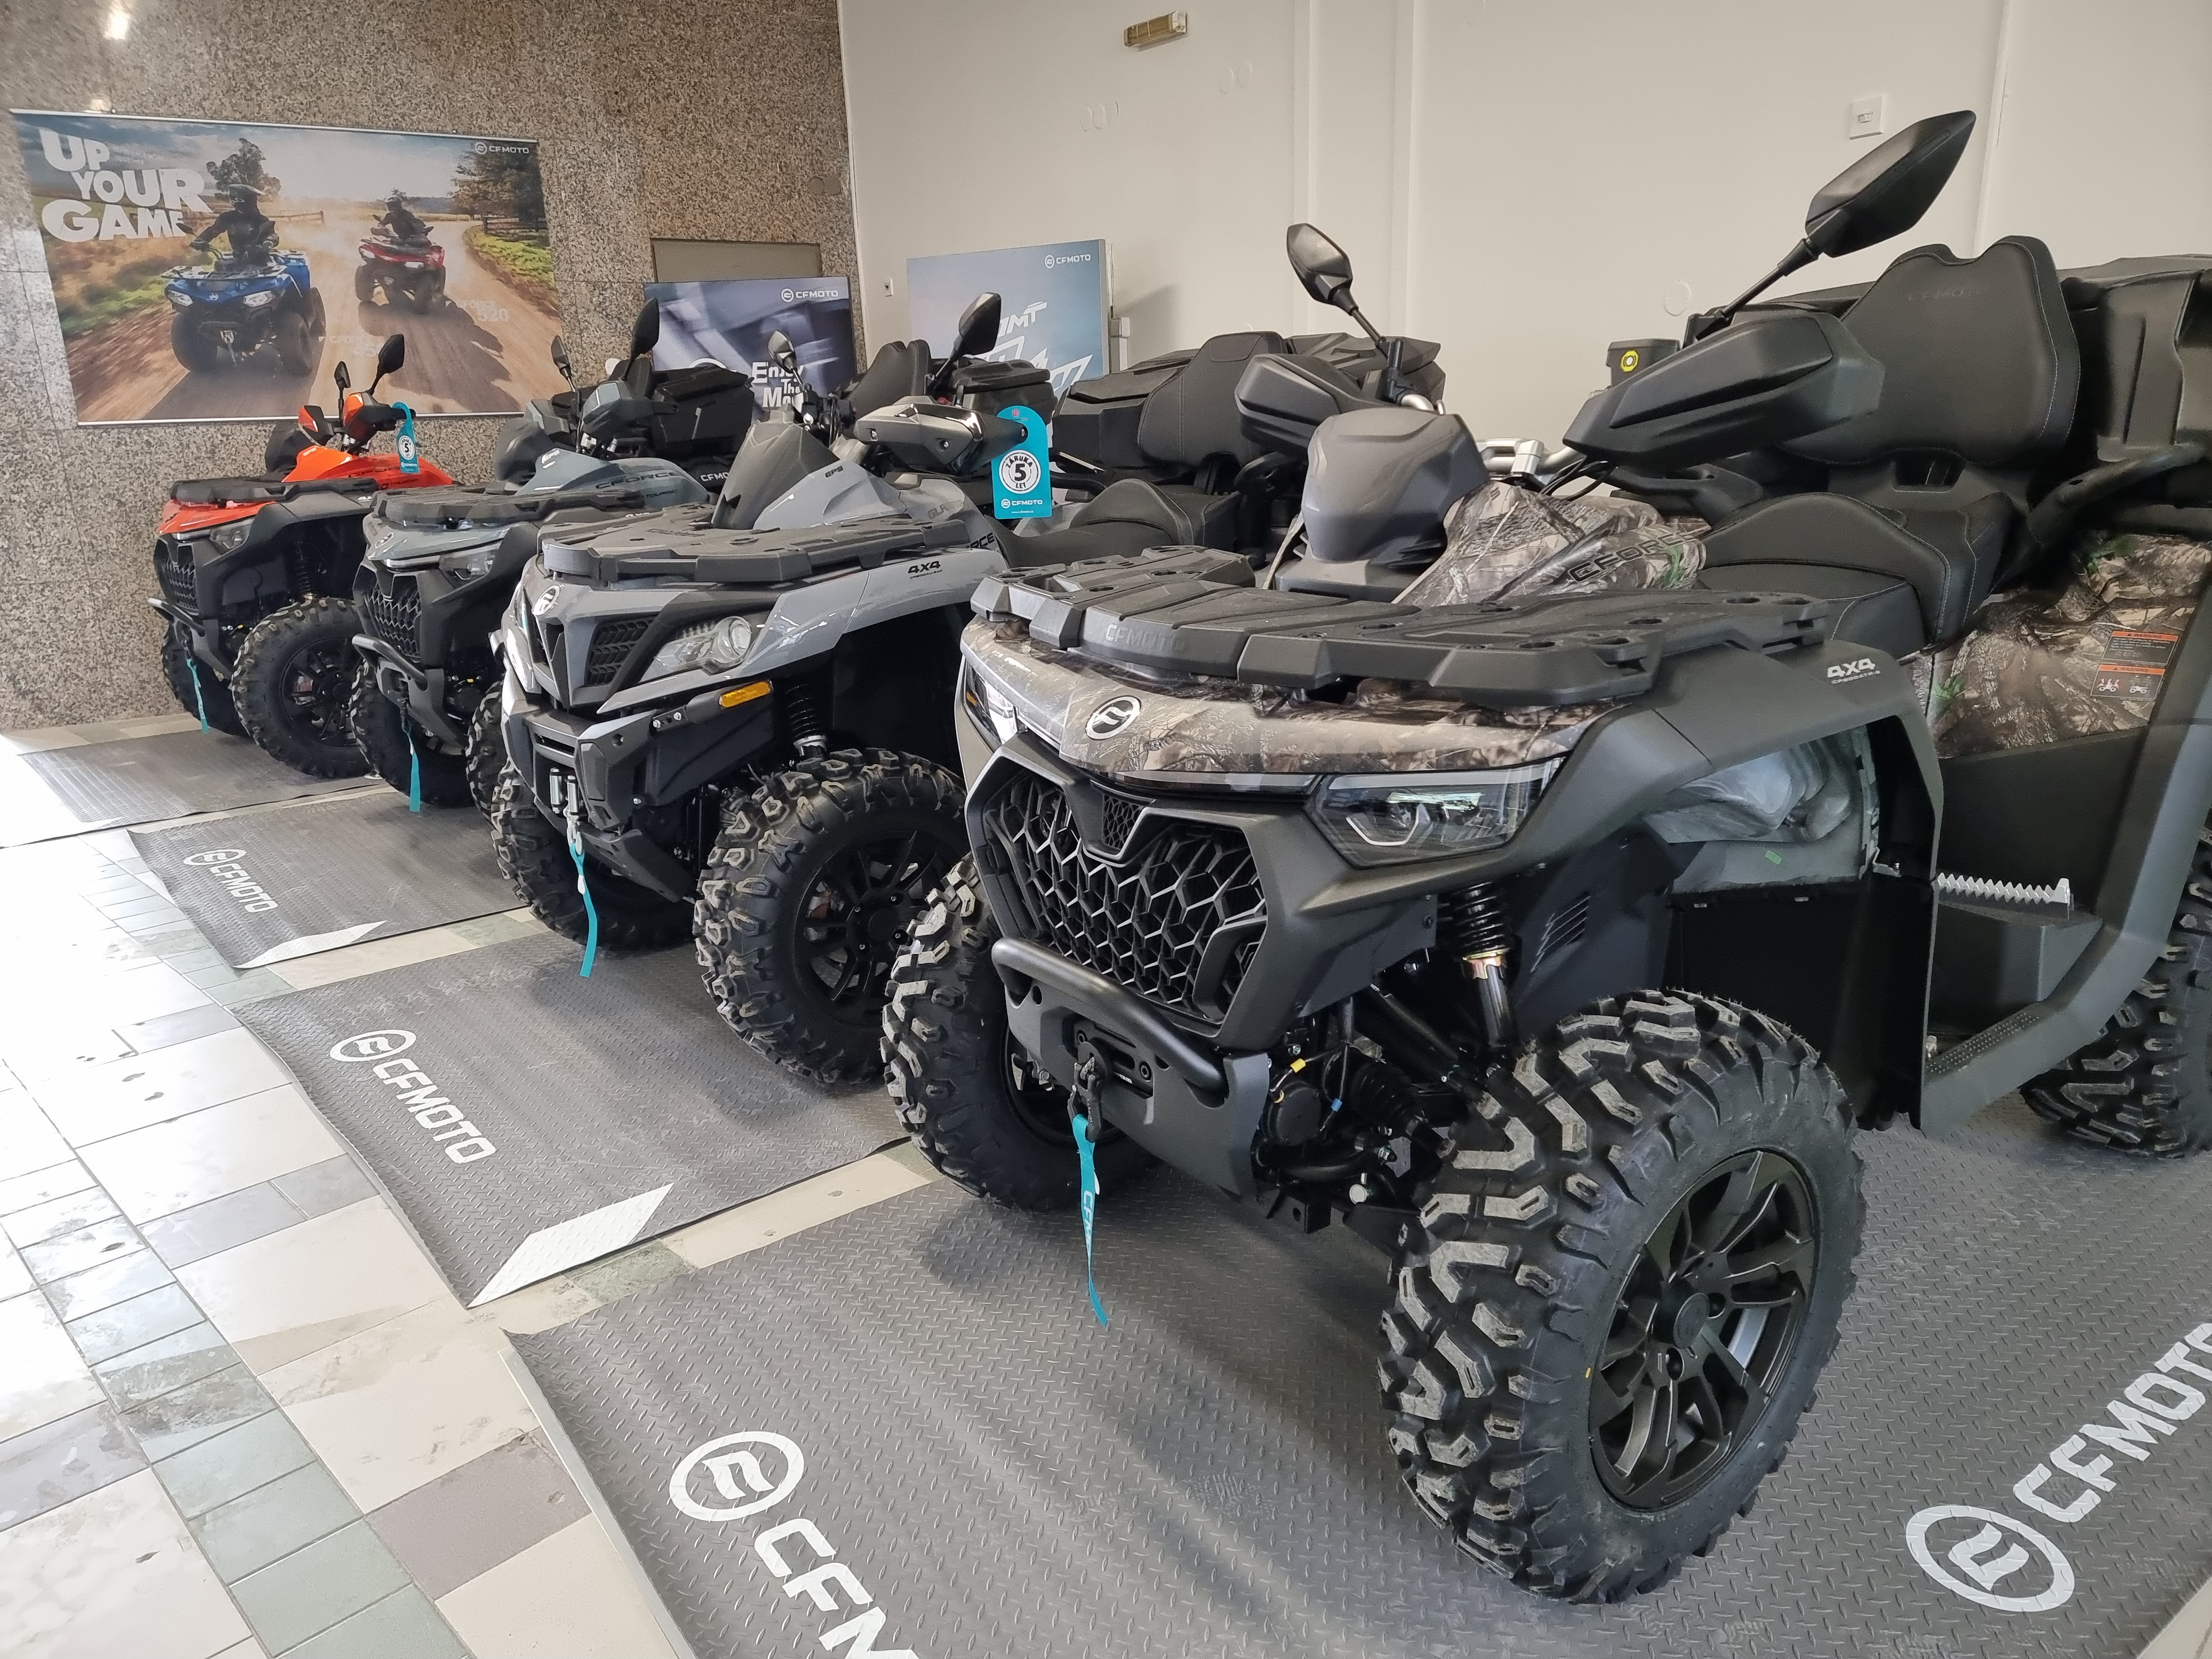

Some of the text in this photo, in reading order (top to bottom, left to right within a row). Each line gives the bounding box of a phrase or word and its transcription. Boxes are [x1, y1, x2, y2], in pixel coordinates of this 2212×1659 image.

[39, 127, 110, 171] UP
[489, 145, 529, 154] CFMOTO
[71, 168, 213, 213] YOUR
[41, 199, 186, 242] GAME
[1056, 254, 1091, 264] CFMOTO
[795, 290, 839, 299] CFMOTO
[780, 378, 801, 394] The
[404, 442, 409, 452] 5
[1005, 455, 1033, 469] ZÁRUKA
[595, 471, 681, 489] CFORCE
[825, 465, 844, 478] EPS
[1014, 463, 1027, 481] 5
[907, 560, 941, 574] 4X4
[1105, 623, 1188, 651] CFMOTO
[1827, 658, 1876, 678] 4X4
[208, 862, 279, 913] CFMOTO
[372, 1057, 497, 1165] CFMOTO
